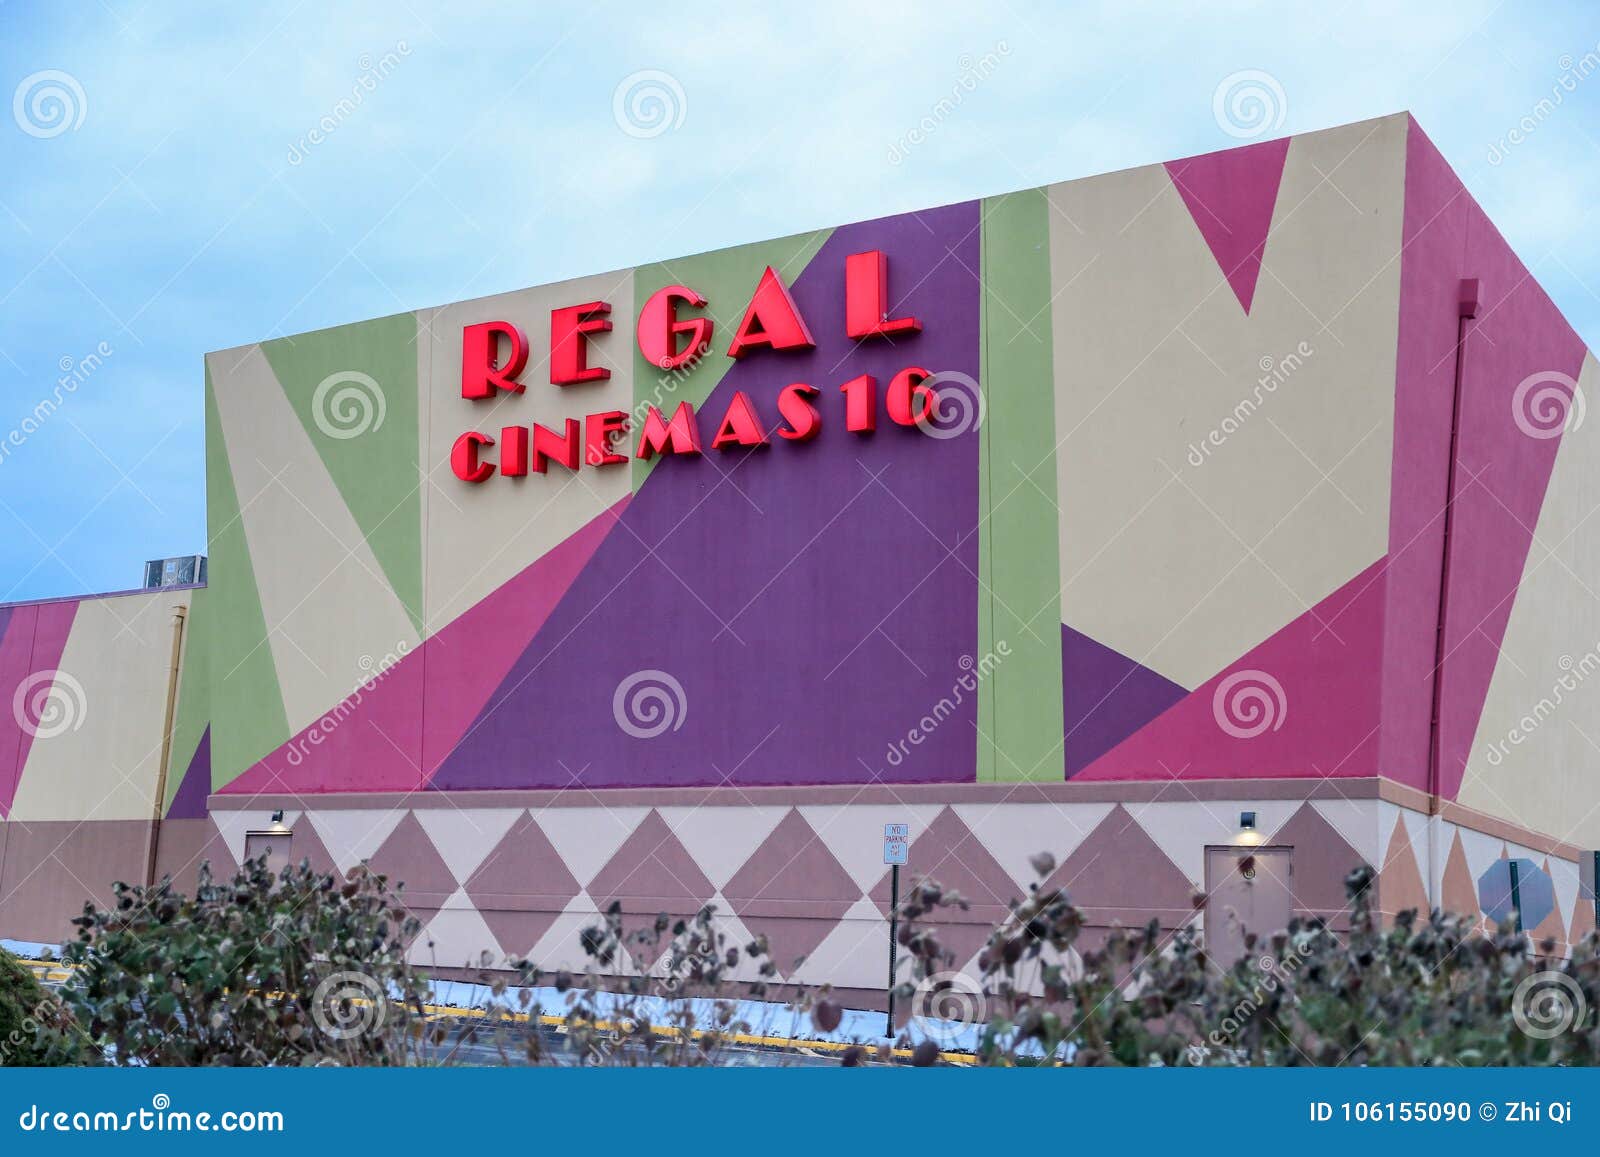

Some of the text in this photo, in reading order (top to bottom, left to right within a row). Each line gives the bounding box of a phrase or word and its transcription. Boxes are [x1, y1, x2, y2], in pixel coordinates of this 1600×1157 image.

[462, 249, 923, 400] REGAL
[891, 826, 901, 835] NO
[886, 836, 908, 844] PARKING
